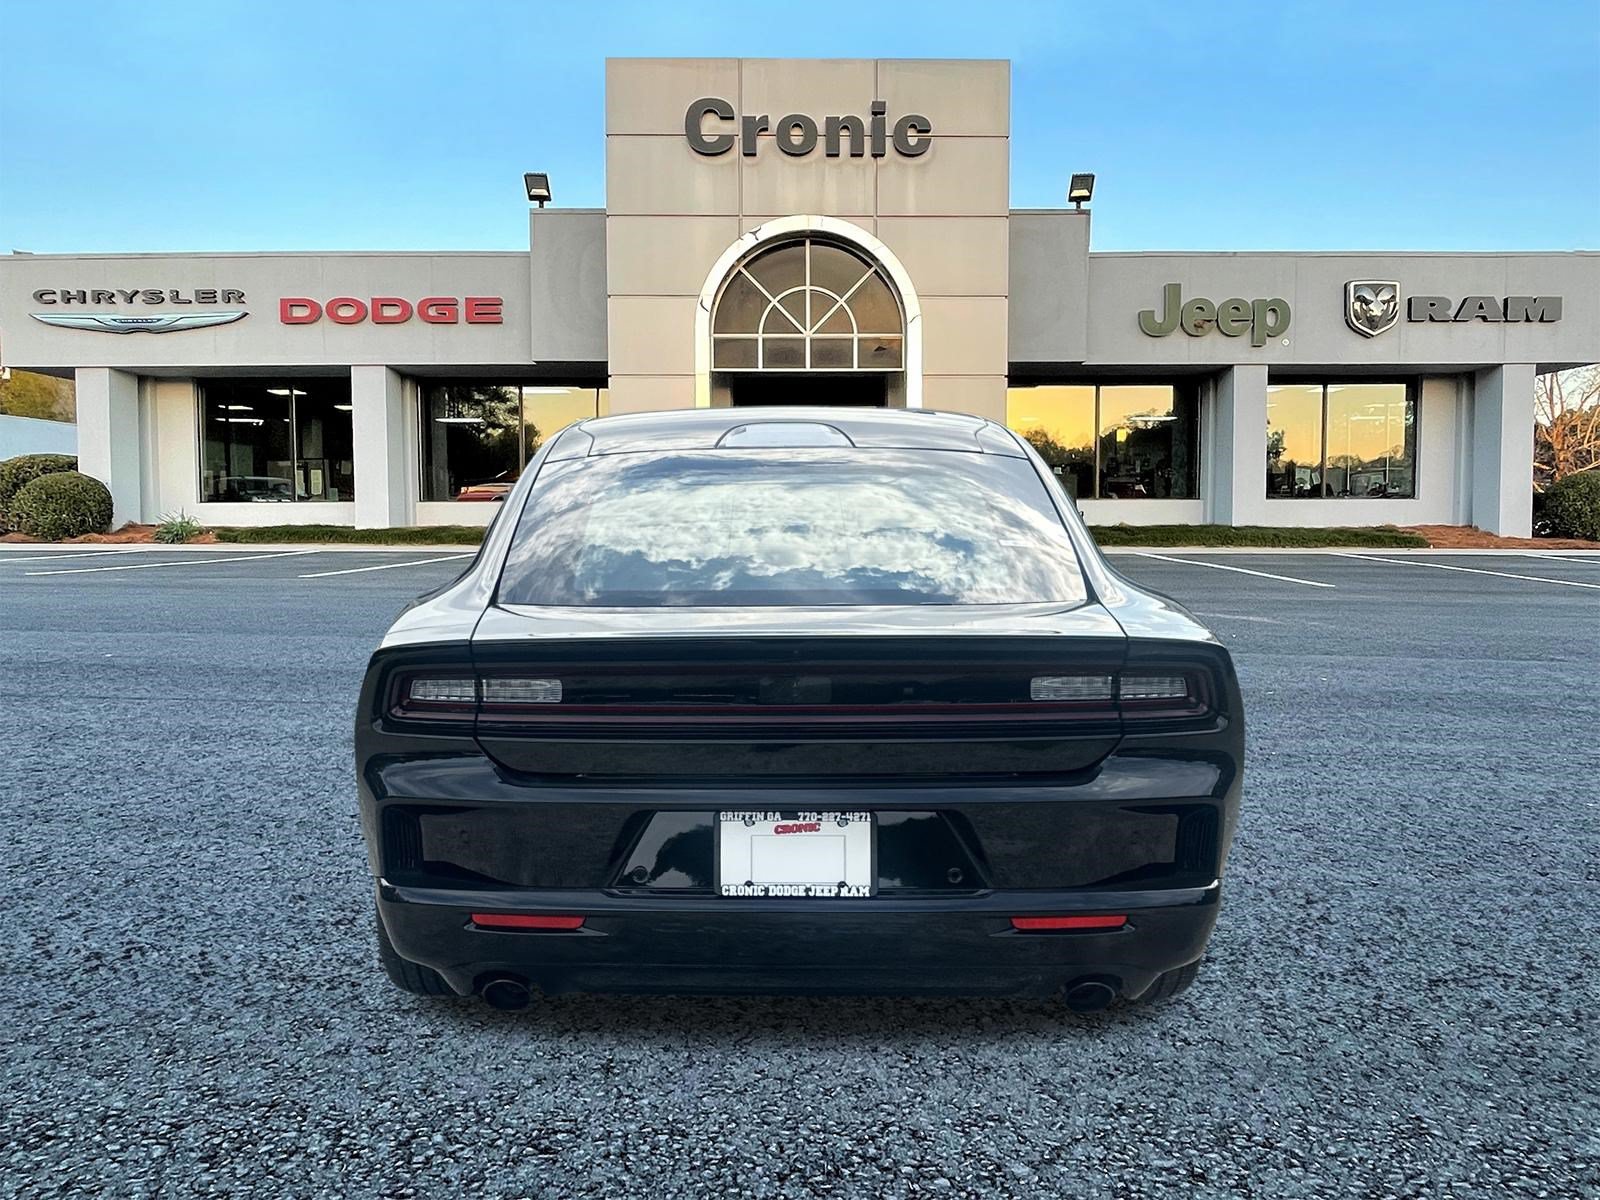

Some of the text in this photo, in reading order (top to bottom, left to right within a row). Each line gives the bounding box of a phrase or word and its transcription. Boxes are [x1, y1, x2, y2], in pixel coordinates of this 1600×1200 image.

[685, 97, 932, 158] Cronic
[32, 289, 247, 305] CHRYSLER
[280, 297, 503, 324] DODGE
[1138, 283, 1292, 347] Jeep
[1407, 296, 1562, 322] RAM
[720, 812, 764, 821] GRIFFIN
[767, 812, 782, 821] GA
[774, 823, 821, 834] CRONIC
[721, 885, 870, 897] CRONIC DODGE JEEP RAM
